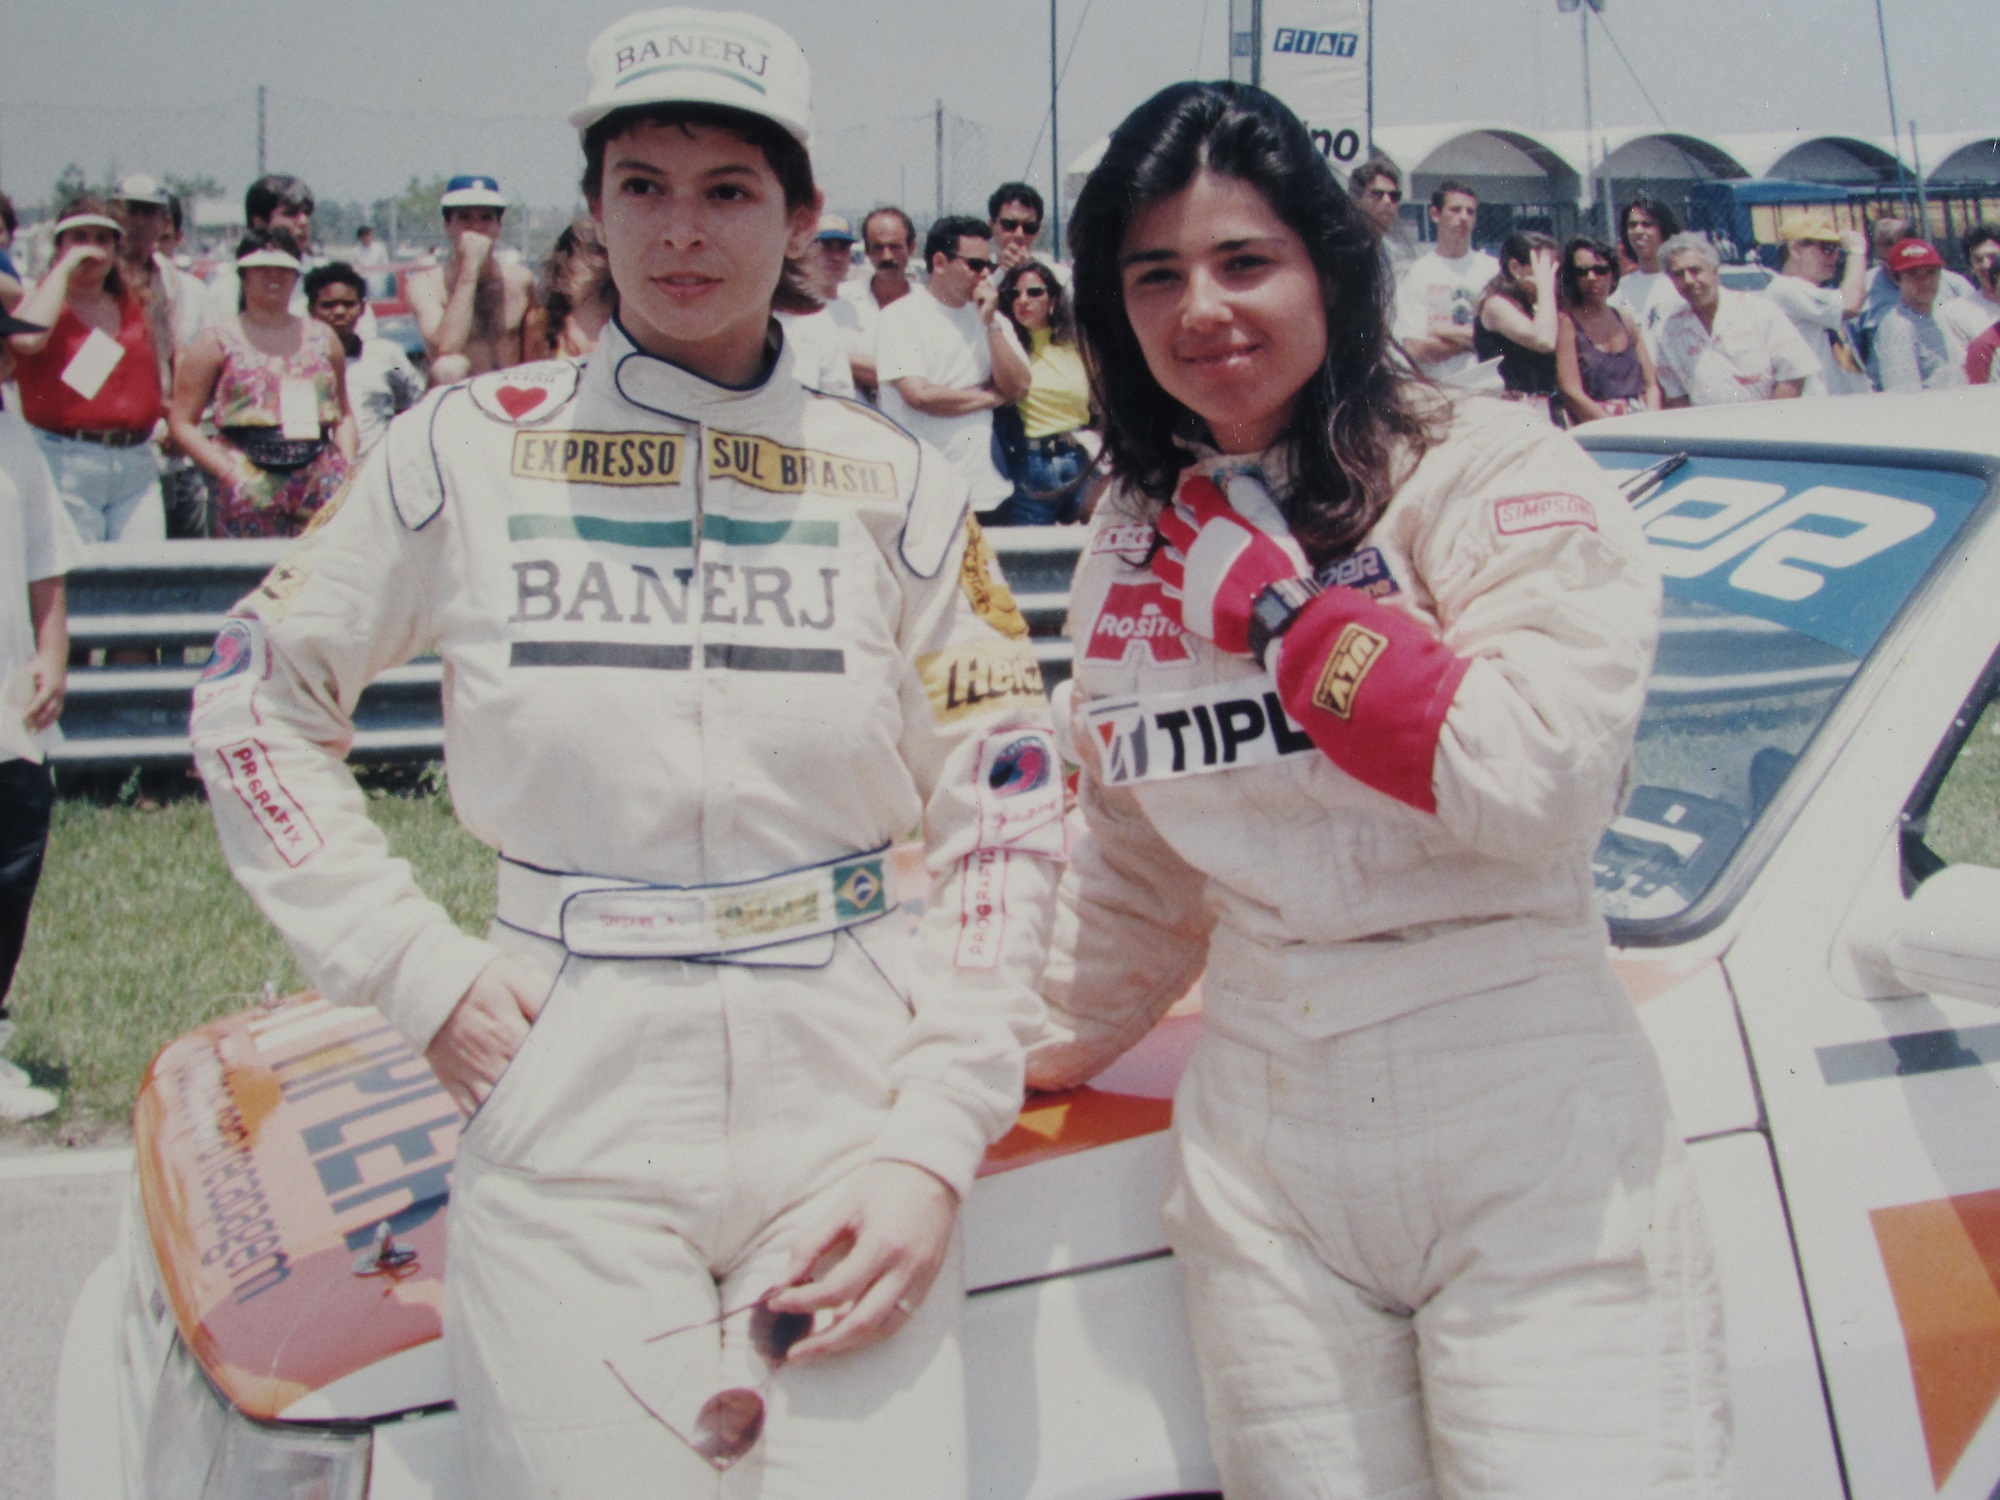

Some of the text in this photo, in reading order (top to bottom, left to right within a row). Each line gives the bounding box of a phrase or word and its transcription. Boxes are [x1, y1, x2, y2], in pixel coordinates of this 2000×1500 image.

[615, 35, 769, 77] BANERJ
[1273, 28, 1358, 58] FIAT
[1306, 127, 1360, 162] no
[521, 436, 887, 495] EXPRESSO SUL BRASIL
[1502, 497, 1590, 523] SIMPSON
[508, 559, 840, 630] BANERJ
